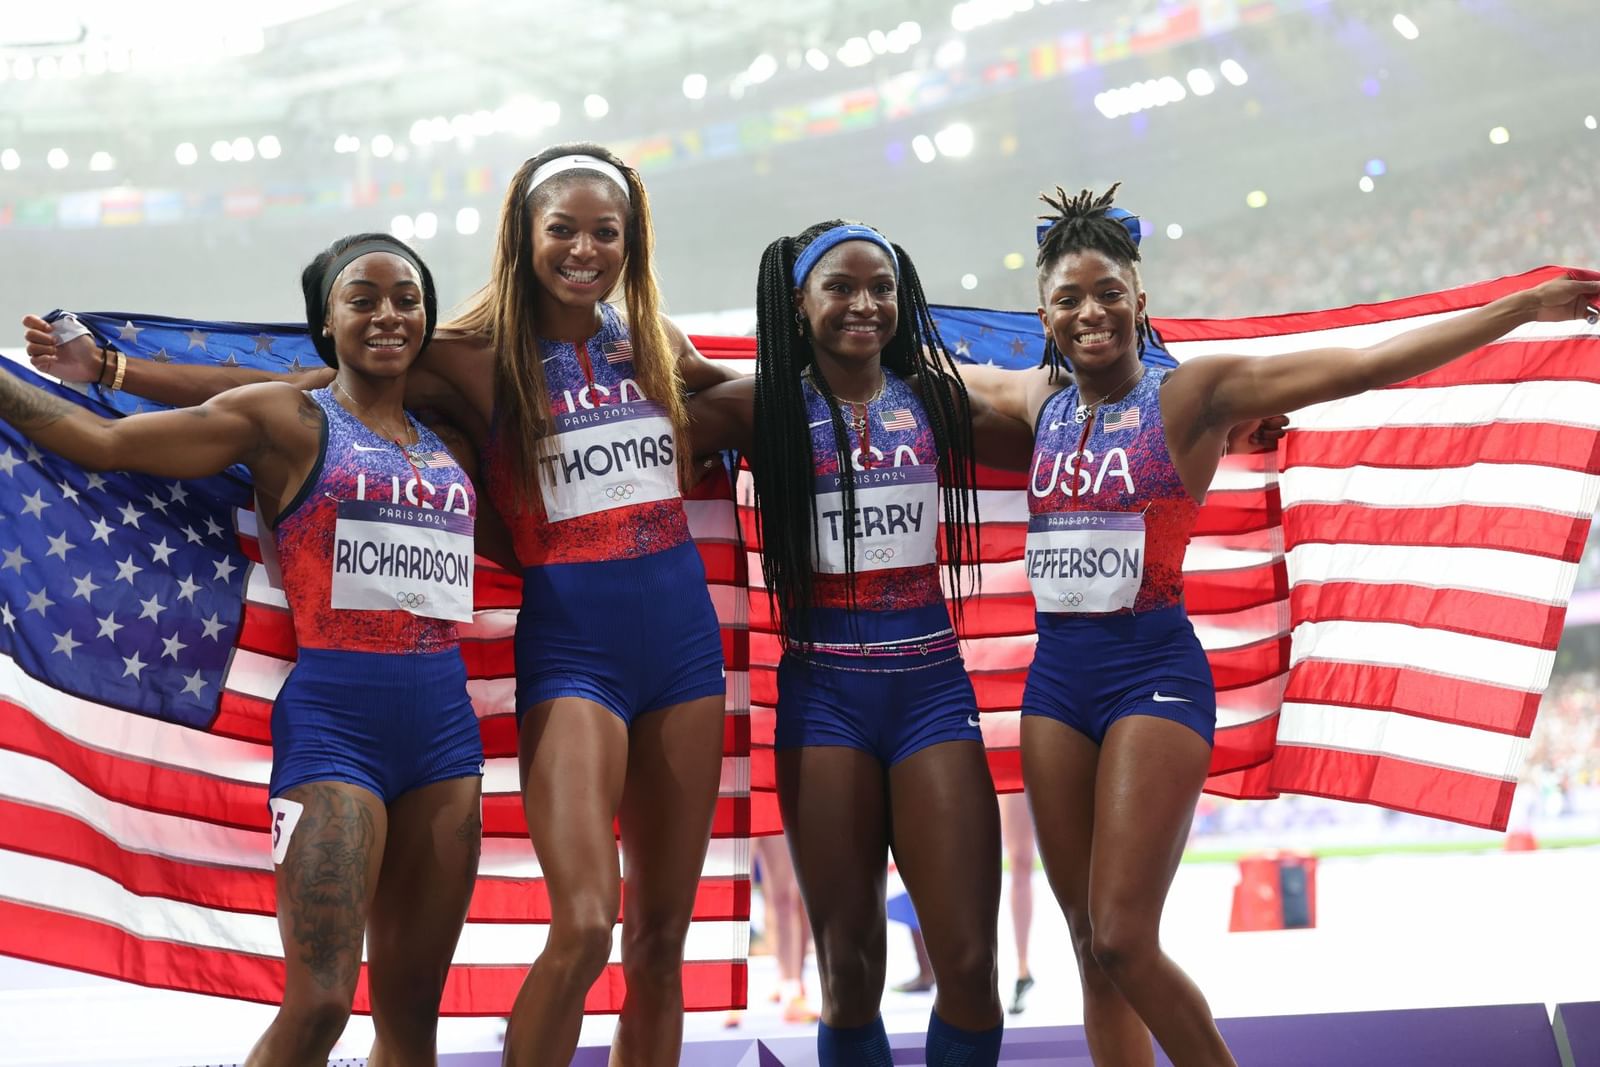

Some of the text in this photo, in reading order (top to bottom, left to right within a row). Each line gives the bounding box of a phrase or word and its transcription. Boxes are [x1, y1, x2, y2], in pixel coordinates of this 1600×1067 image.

[564, 407, 635, 427] PARIS 2024
[539, 434, 674, 488] THOMAS
[834, 472, 906, 486] PRIS 2024
[1031, 448, 1136, 498] USA
[356, 474, 469, 516] USA
[379, 507, 447, 526] PARIS 2024
[822, 502, 924, 541] TERRY
[1048, 516, 1106, 526] PARIS 2024
[335, 539, 469, 588] RICHARDSON
[273, 811, 286, 850] 5
